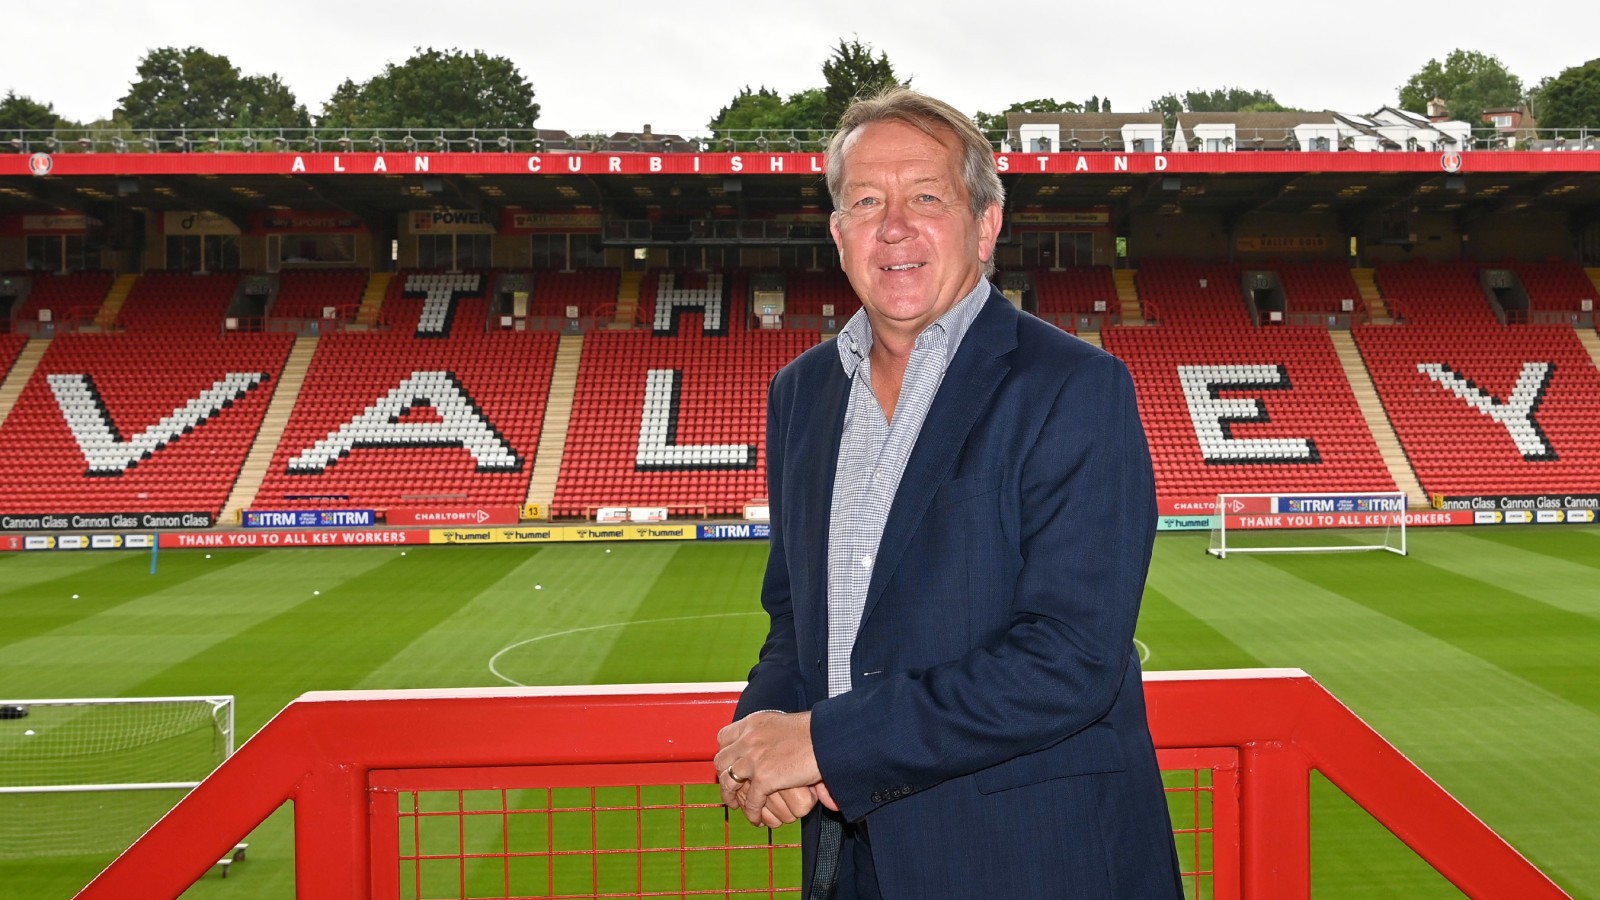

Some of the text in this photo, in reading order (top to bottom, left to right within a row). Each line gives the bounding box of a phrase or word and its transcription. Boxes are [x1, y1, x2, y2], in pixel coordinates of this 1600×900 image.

[292, 156, 1168, 172] ALAN CURBISHL STAND
[291, 217, 335, 227] SPORTS
[47, 363, 1557, 475] VALEY
[1301, 499, 1334, 512] ITRM
[1368, 497, 1402, 510] ITRM
[1443, 499, 1471, 509] annon
[1472, 498, 1496, 509] Glass
[1501, 497, 1534, 508] Cannon
[1537, 497, 1561, 508] Glass
[1565, 496, 1599, 507] Cannon
[332, 511, 369, 524] ITRM
[528, 507, 538, 516] 13
[2, 513, 209, 529] Cannon Glass Cannon Glass Cannon Glass
[259, 512, 296, 525] ITRM
[1175, 518, 1210, 528] hummel
[1240, 513, 1451, 527] THANK YOU TO ALL KEY WORKERS
[178, 531, 406, 545] THANK YOU TO ALL KEY WORKERS
[454, 531, 491, 541] hummel
[515, 529, 551, 540] hummel
[588, 528, 624, 539] hummel
[648, 527, 684, 538] hummel
[716, 525, 750, 538] ITRM
